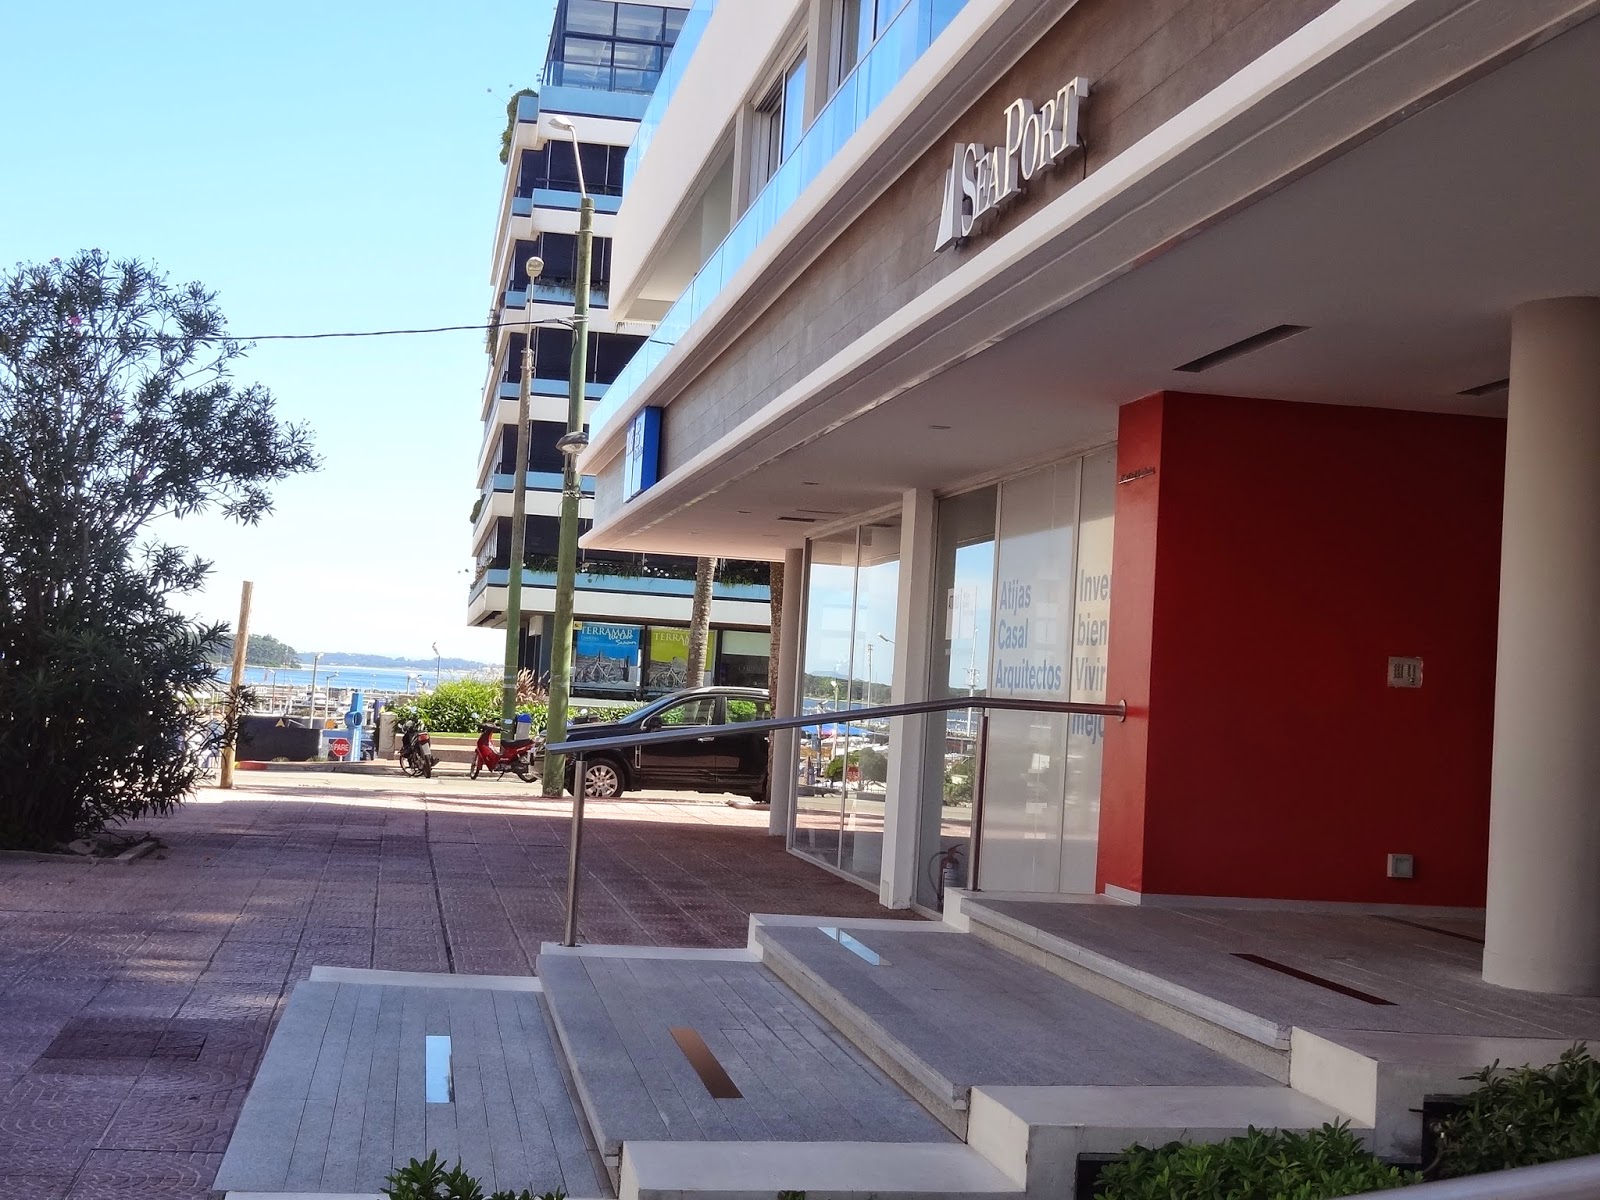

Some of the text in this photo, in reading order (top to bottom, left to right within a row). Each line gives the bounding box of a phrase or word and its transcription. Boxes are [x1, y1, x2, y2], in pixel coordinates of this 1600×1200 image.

[999, 579, 1032, 616] Atijas
[580, 626, 634, 637] TERRAMAR
[998, 618, 1029, 650] Casal
[1077, 613, 1107, 647] bien
[995, 658, 1062, 696] Arquitectos
[1075, 656, 1106, 692] Vivir
[333, 743, 349, 752] PARE
